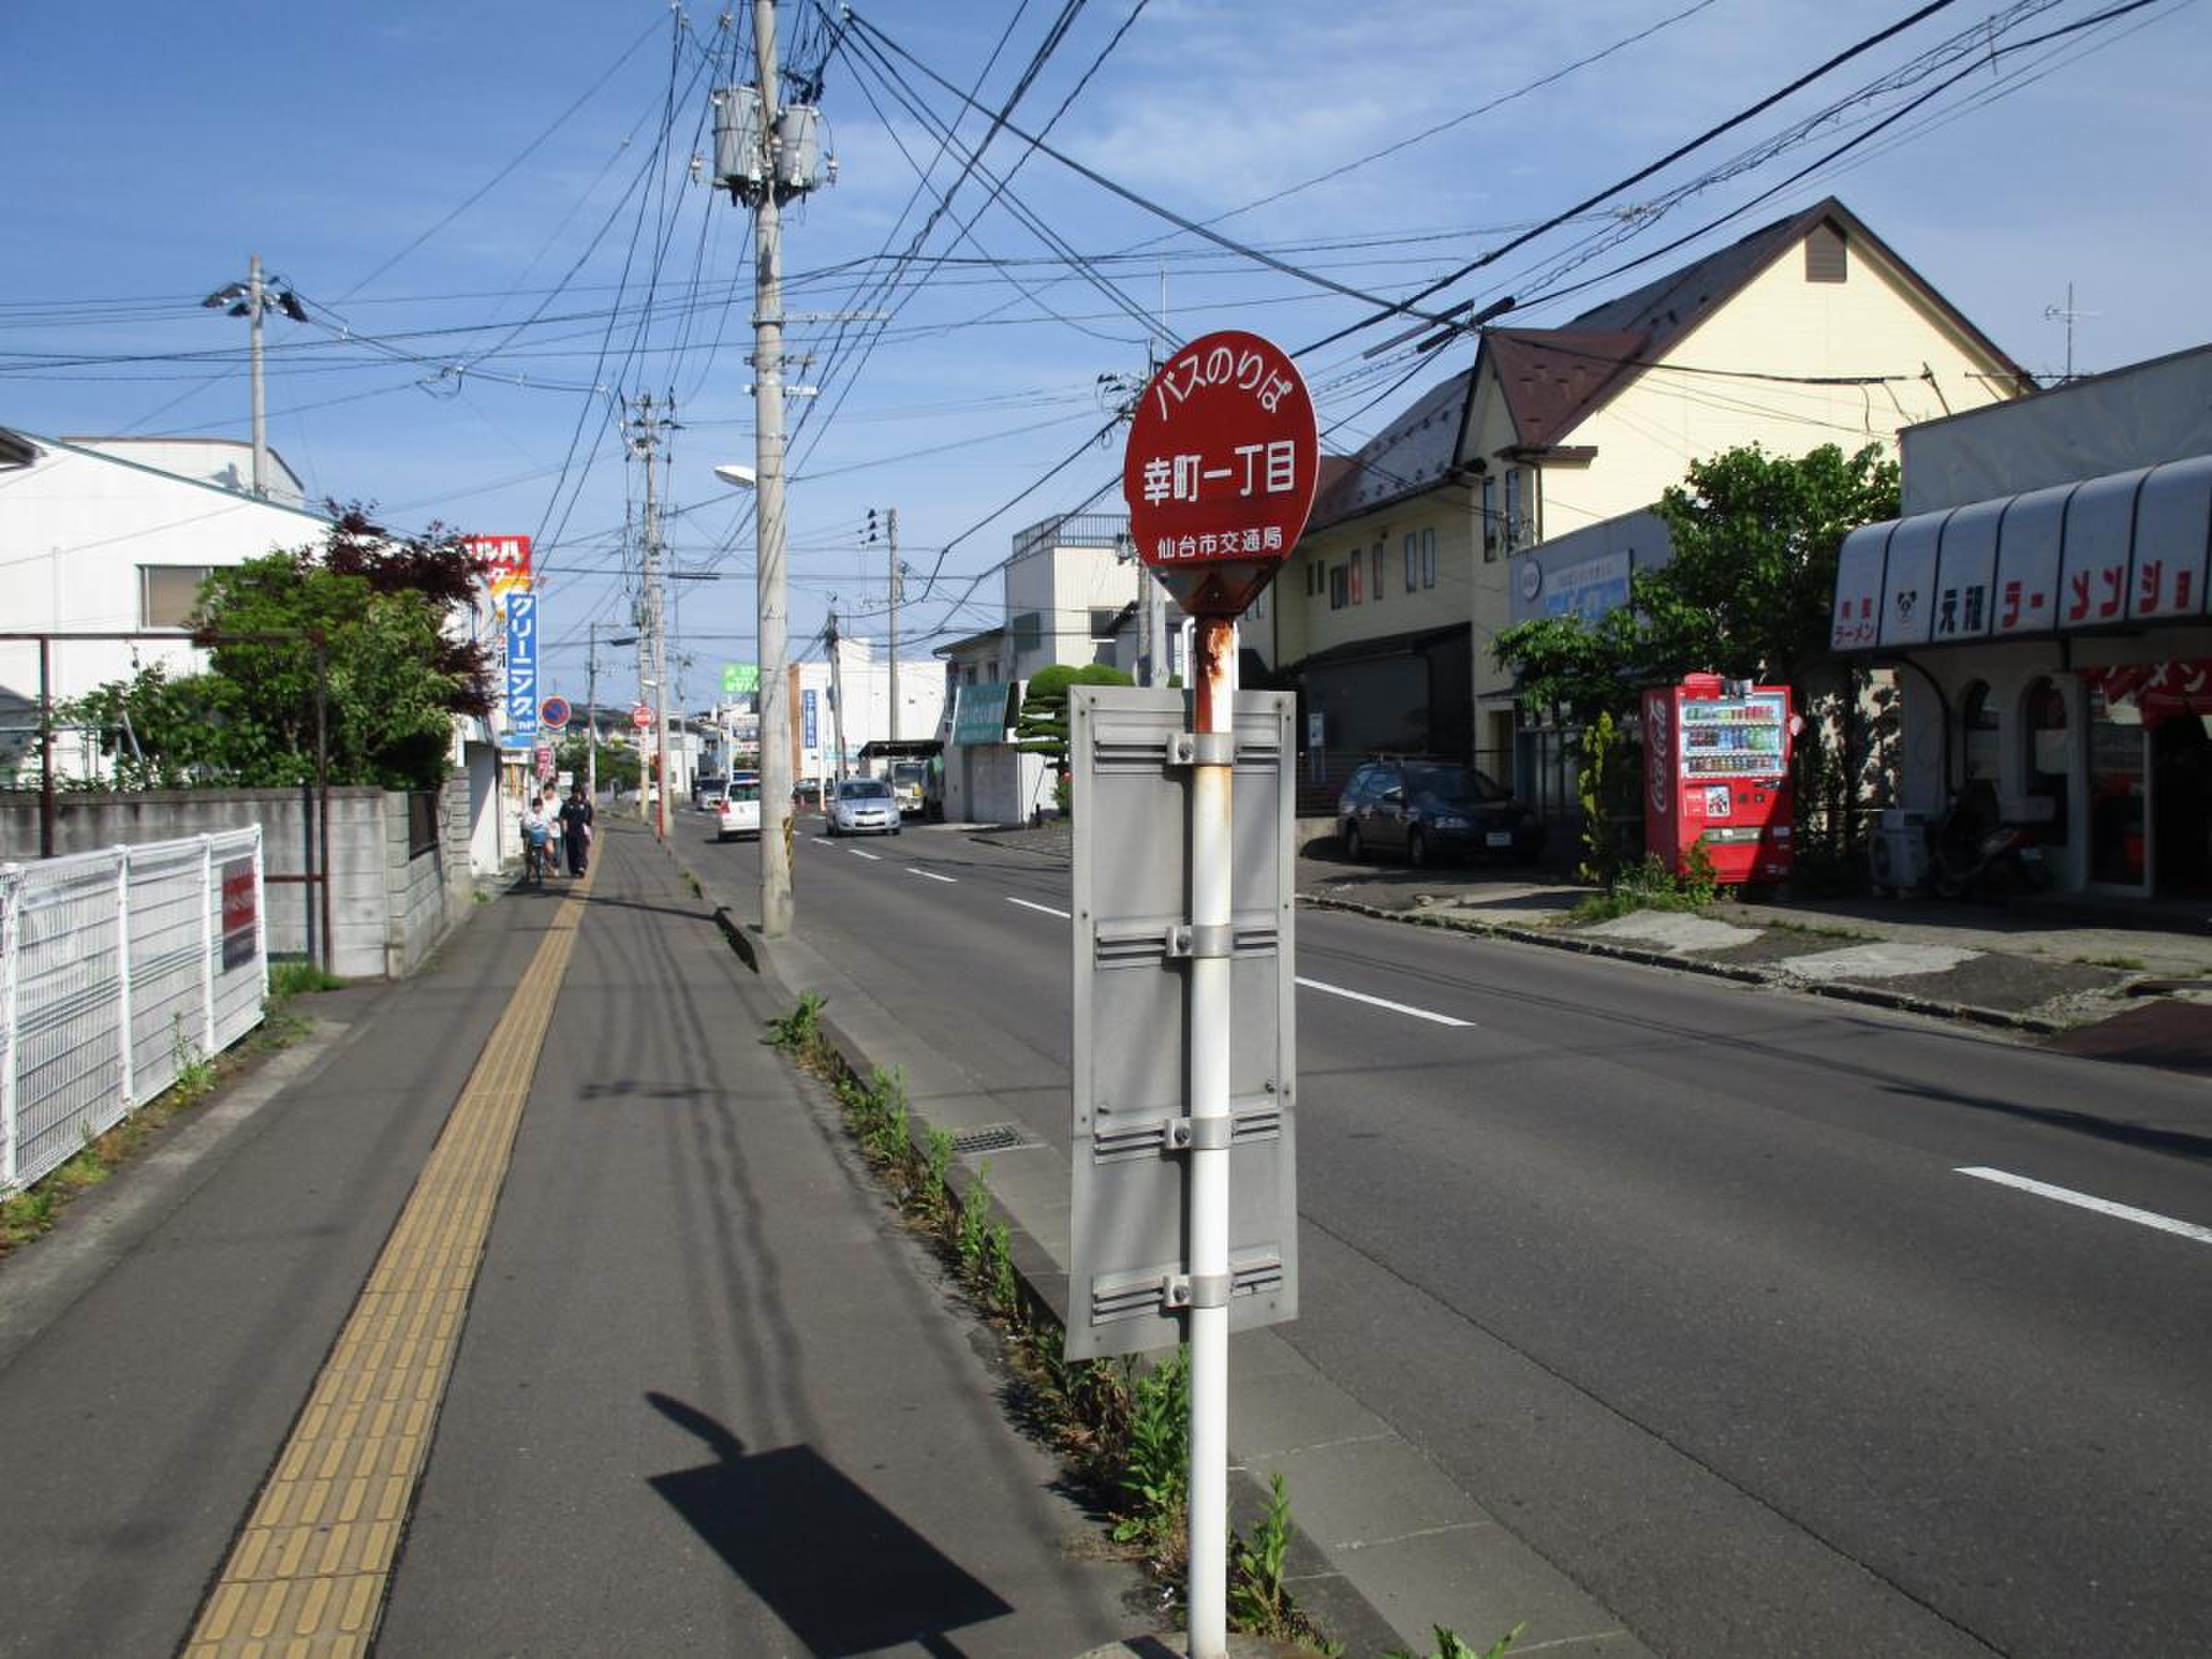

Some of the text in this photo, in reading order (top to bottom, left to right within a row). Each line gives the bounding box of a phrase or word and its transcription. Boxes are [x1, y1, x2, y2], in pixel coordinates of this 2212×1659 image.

[1156, 347, 1293, 422] バスのりば
[1144, 440, 1295, 507] 幸町一丁目
[1158, 525, 1283, 560] 仙台市交通局
[512, 599, 534, 717] クリーニング
